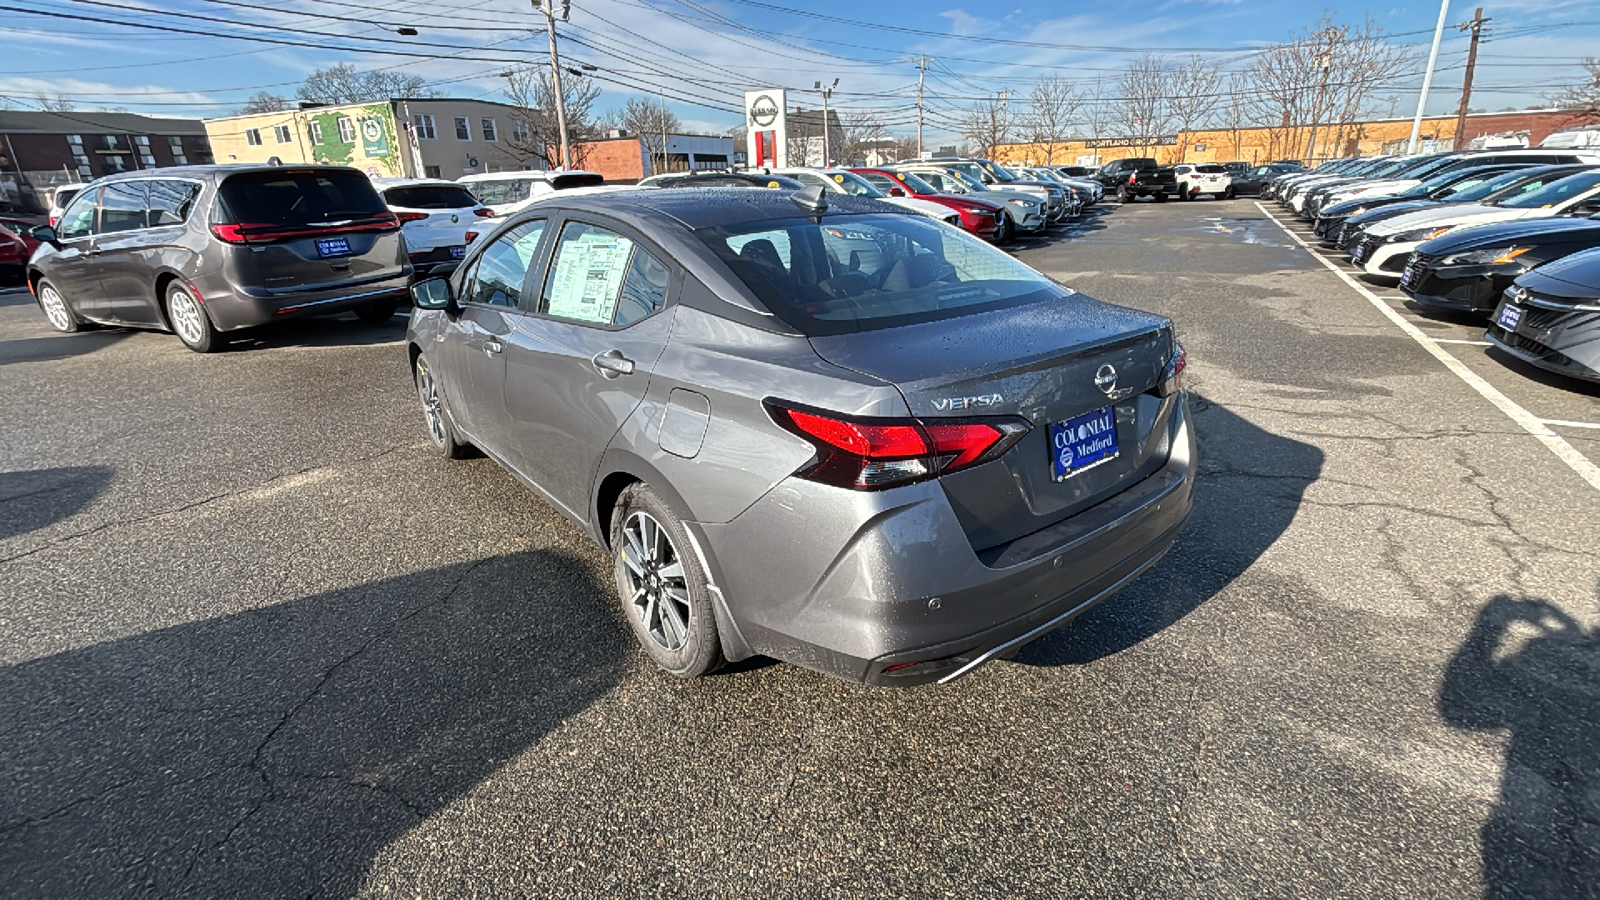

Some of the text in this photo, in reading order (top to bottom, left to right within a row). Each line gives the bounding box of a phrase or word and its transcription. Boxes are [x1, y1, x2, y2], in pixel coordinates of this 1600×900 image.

[931, 393, 1004, 411] VERSA
[1055, 415, 1113, 449] COLONIAL
[1076, 434, 1112, 459] Medford
